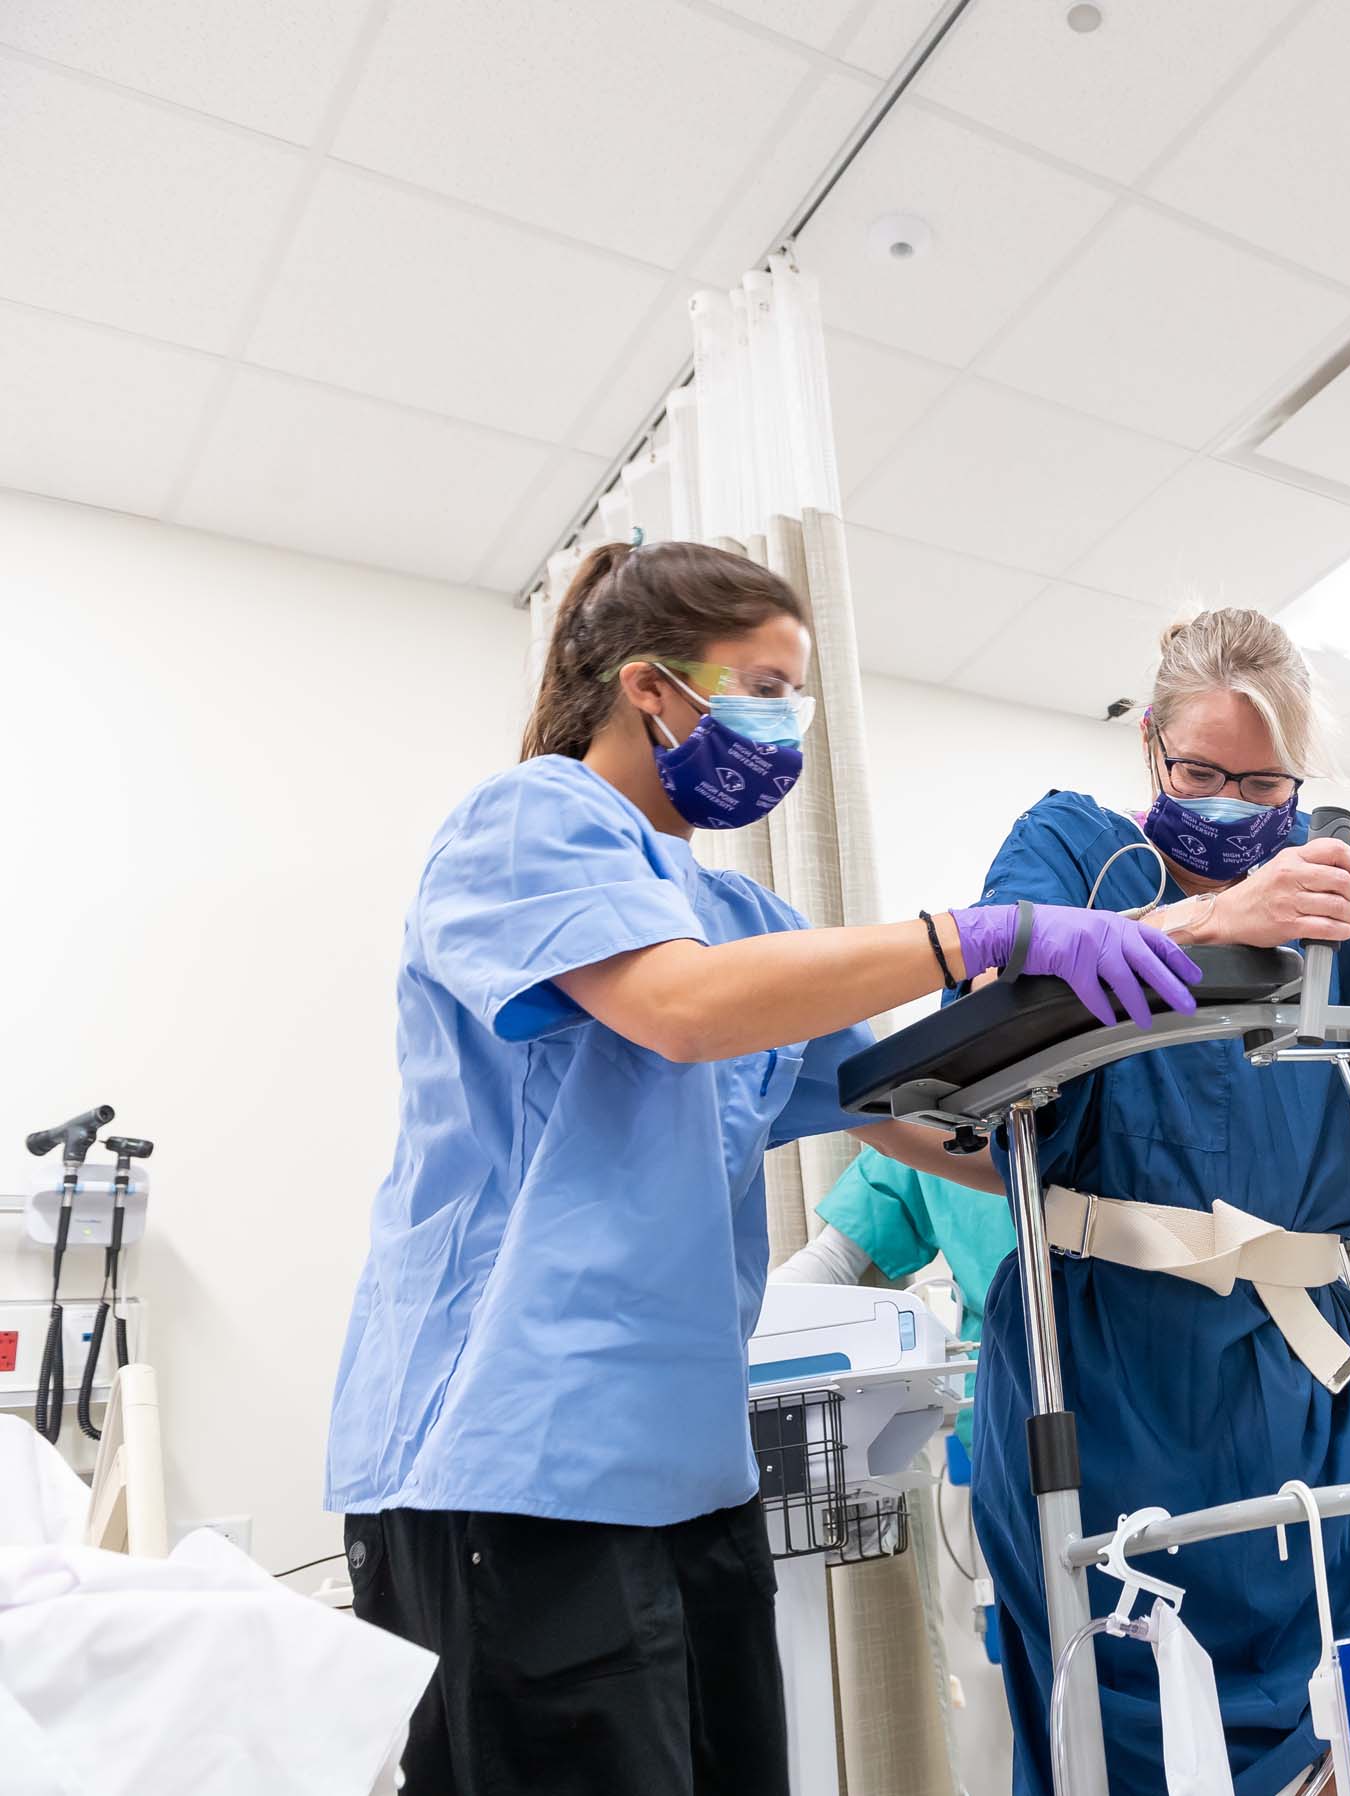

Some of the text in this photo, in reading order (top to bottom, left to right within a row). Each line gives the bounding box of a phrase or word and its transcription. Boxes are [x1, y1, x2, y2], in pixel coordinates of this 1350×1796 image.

[732, 742, 773, 769] HIGH POINT
[700, 781, 719, 795] HIGH
[718, 792, 740, 806] POINT
[1181, 817, 1218, 839] UNIVERSITY
[1182, 812, 1218, 833] HIGH POINT
[1171, 847, 1209, 867] HIGH POINT
